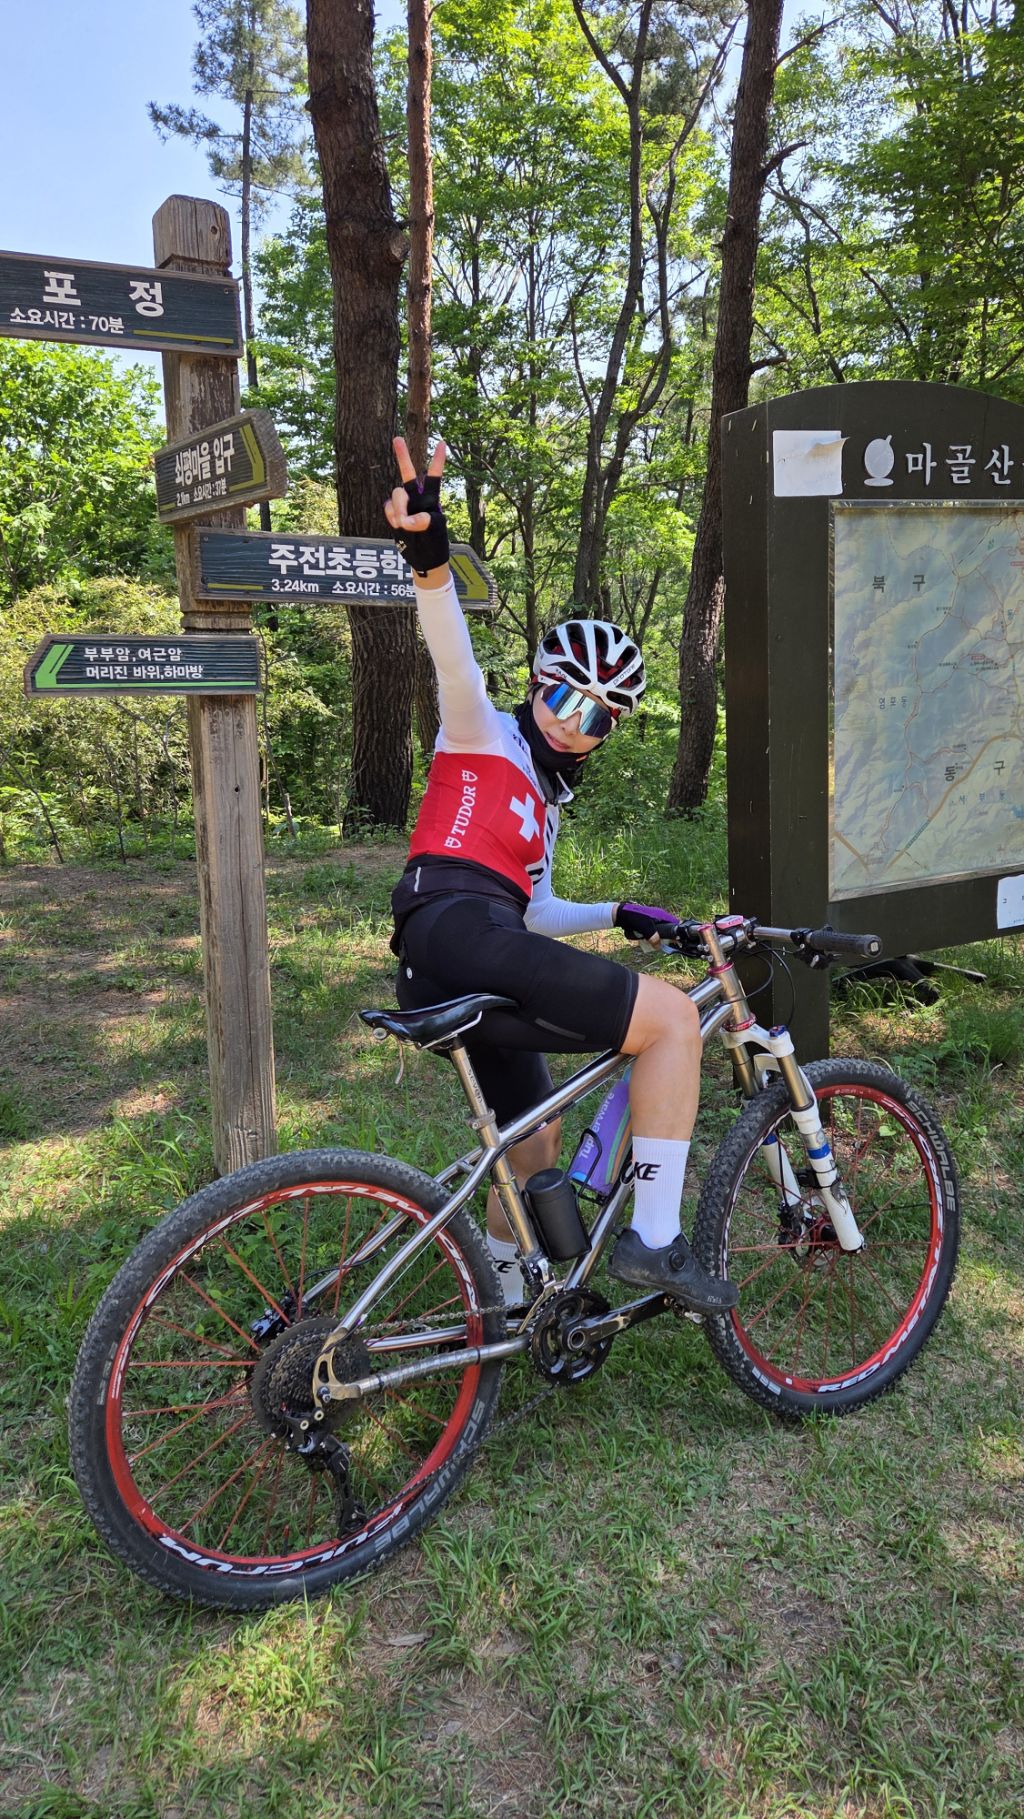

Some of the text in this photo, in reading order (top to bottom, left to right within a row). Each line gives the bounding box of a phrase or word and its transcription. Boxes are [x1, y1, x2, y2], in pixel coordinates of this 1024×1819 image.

[175, 433, 235, 487] 쇠평마을 입구
[905, 442, 1024, 485] 마골산
[268, 543, 413, 581] 주전초등학
[271, 578, 319, 593] 3.24km
[86, 665, 128, 680] 머리진
[451, 785, 477, 837] TUDOR
[579, 1092, 615, 1159] Tuperware
[905, 1099, 956, 1213] SCHWALBE
